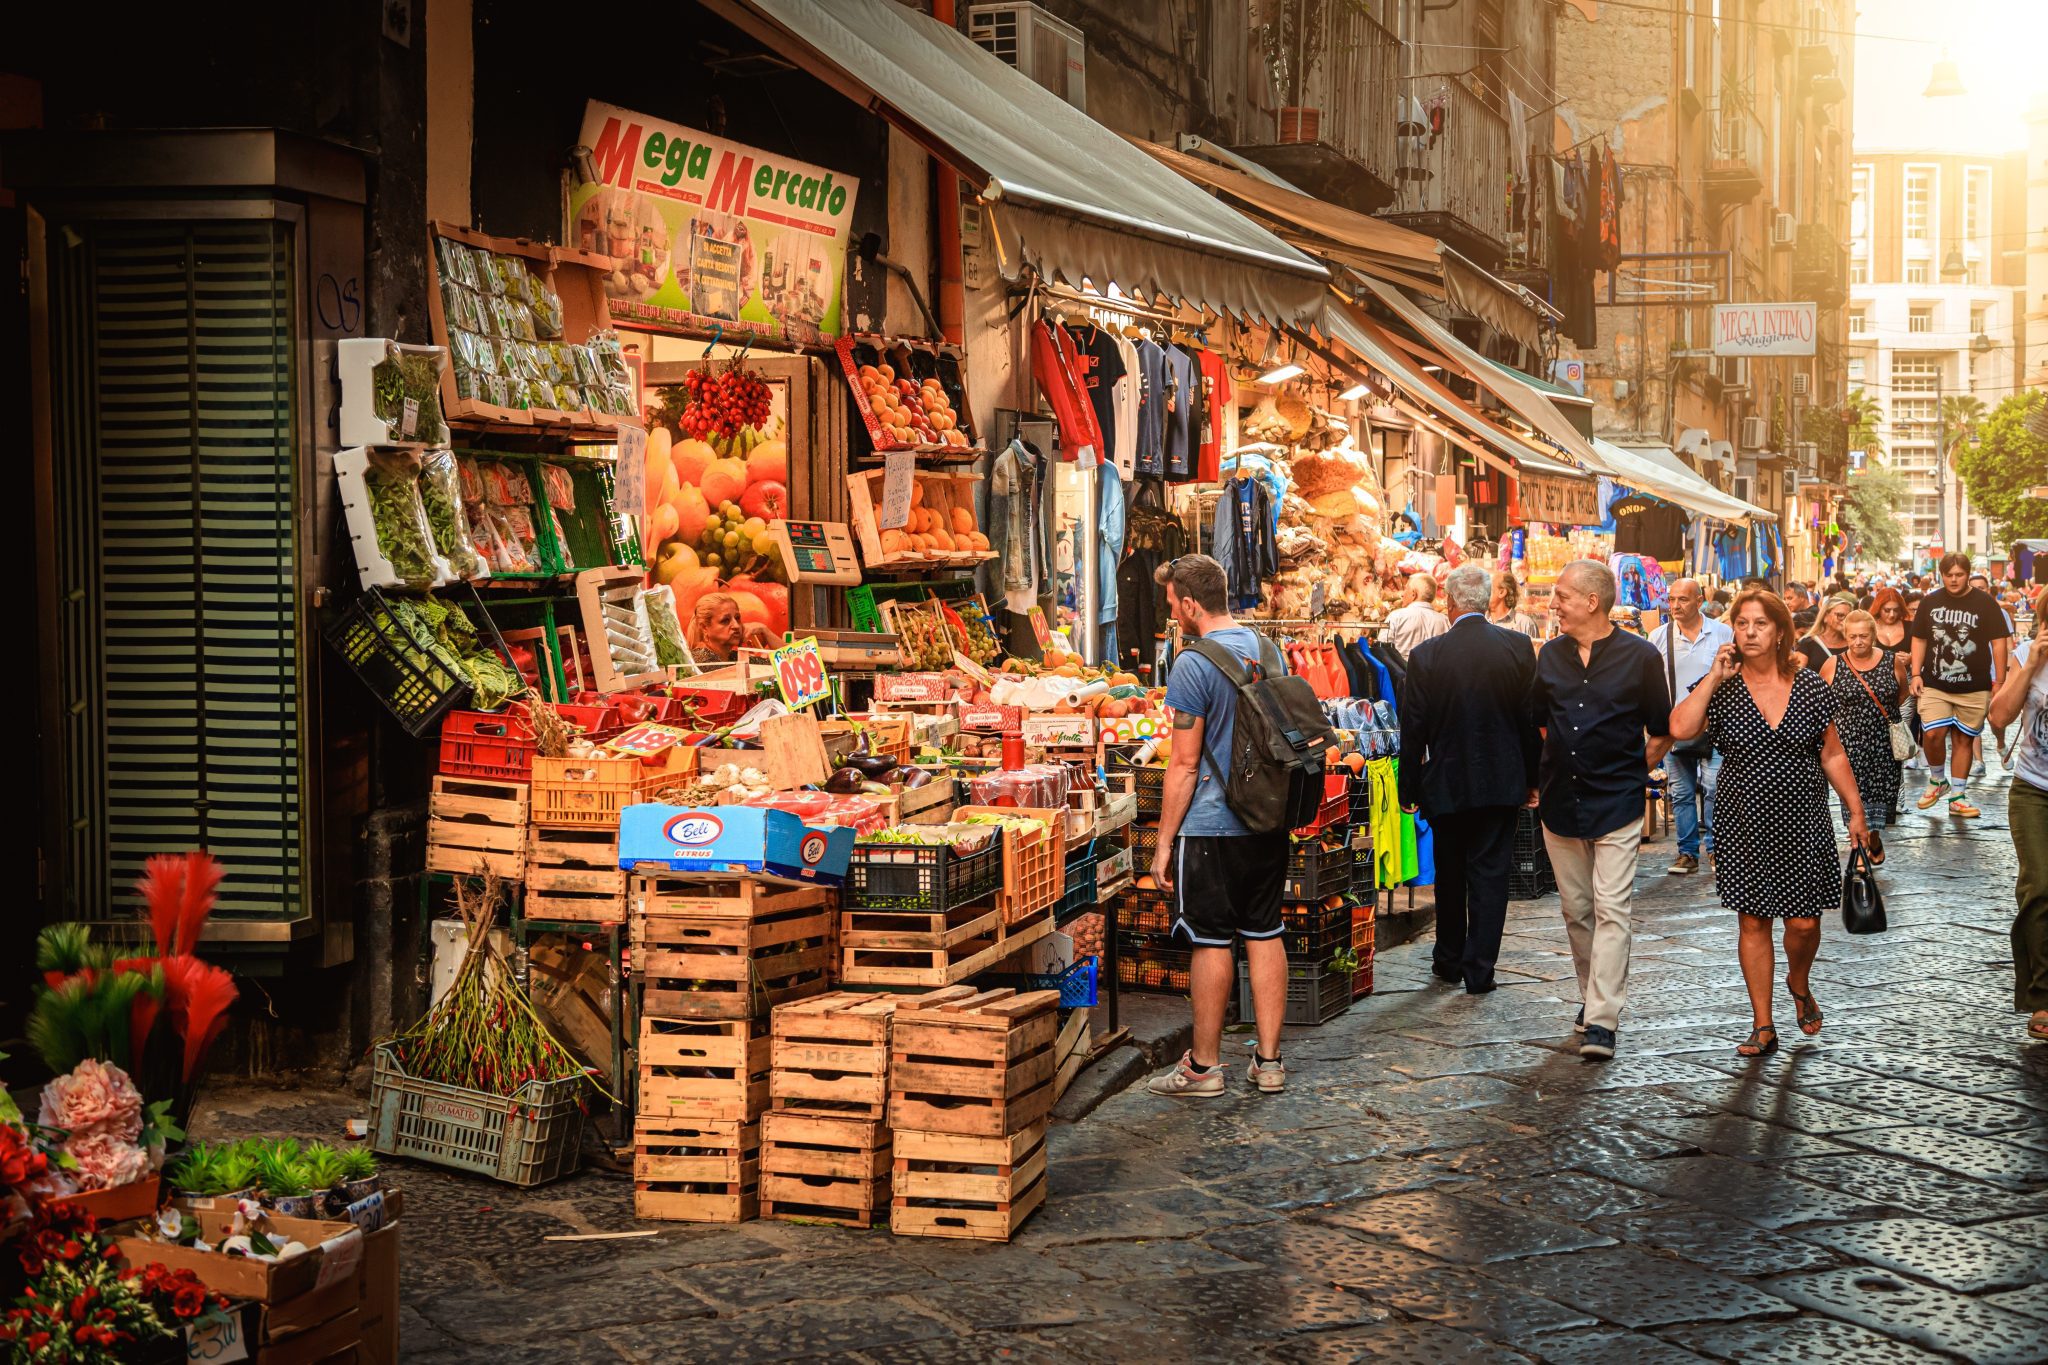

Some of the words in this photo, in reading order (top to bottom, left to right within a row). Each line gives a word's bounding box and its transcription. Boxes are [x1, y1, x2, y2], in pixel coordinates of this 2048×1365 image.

[593, 116, 713, 190] Mega
[705, 151, 847, 217] Mercato
[968, 262, 978, 280] 68
[1717, 310, 1758, 345] MEGA
[1763, 309, 1813, 342] INTIMO
[1735, 331, 1795, 348] Ruggiero
[1930, 606, 1979, 629] Tupac
[682, 822, 709, 839] Beli
[807, 841, 820, 856] Beli
[448, 1106, 480, 1120] MATTEO
